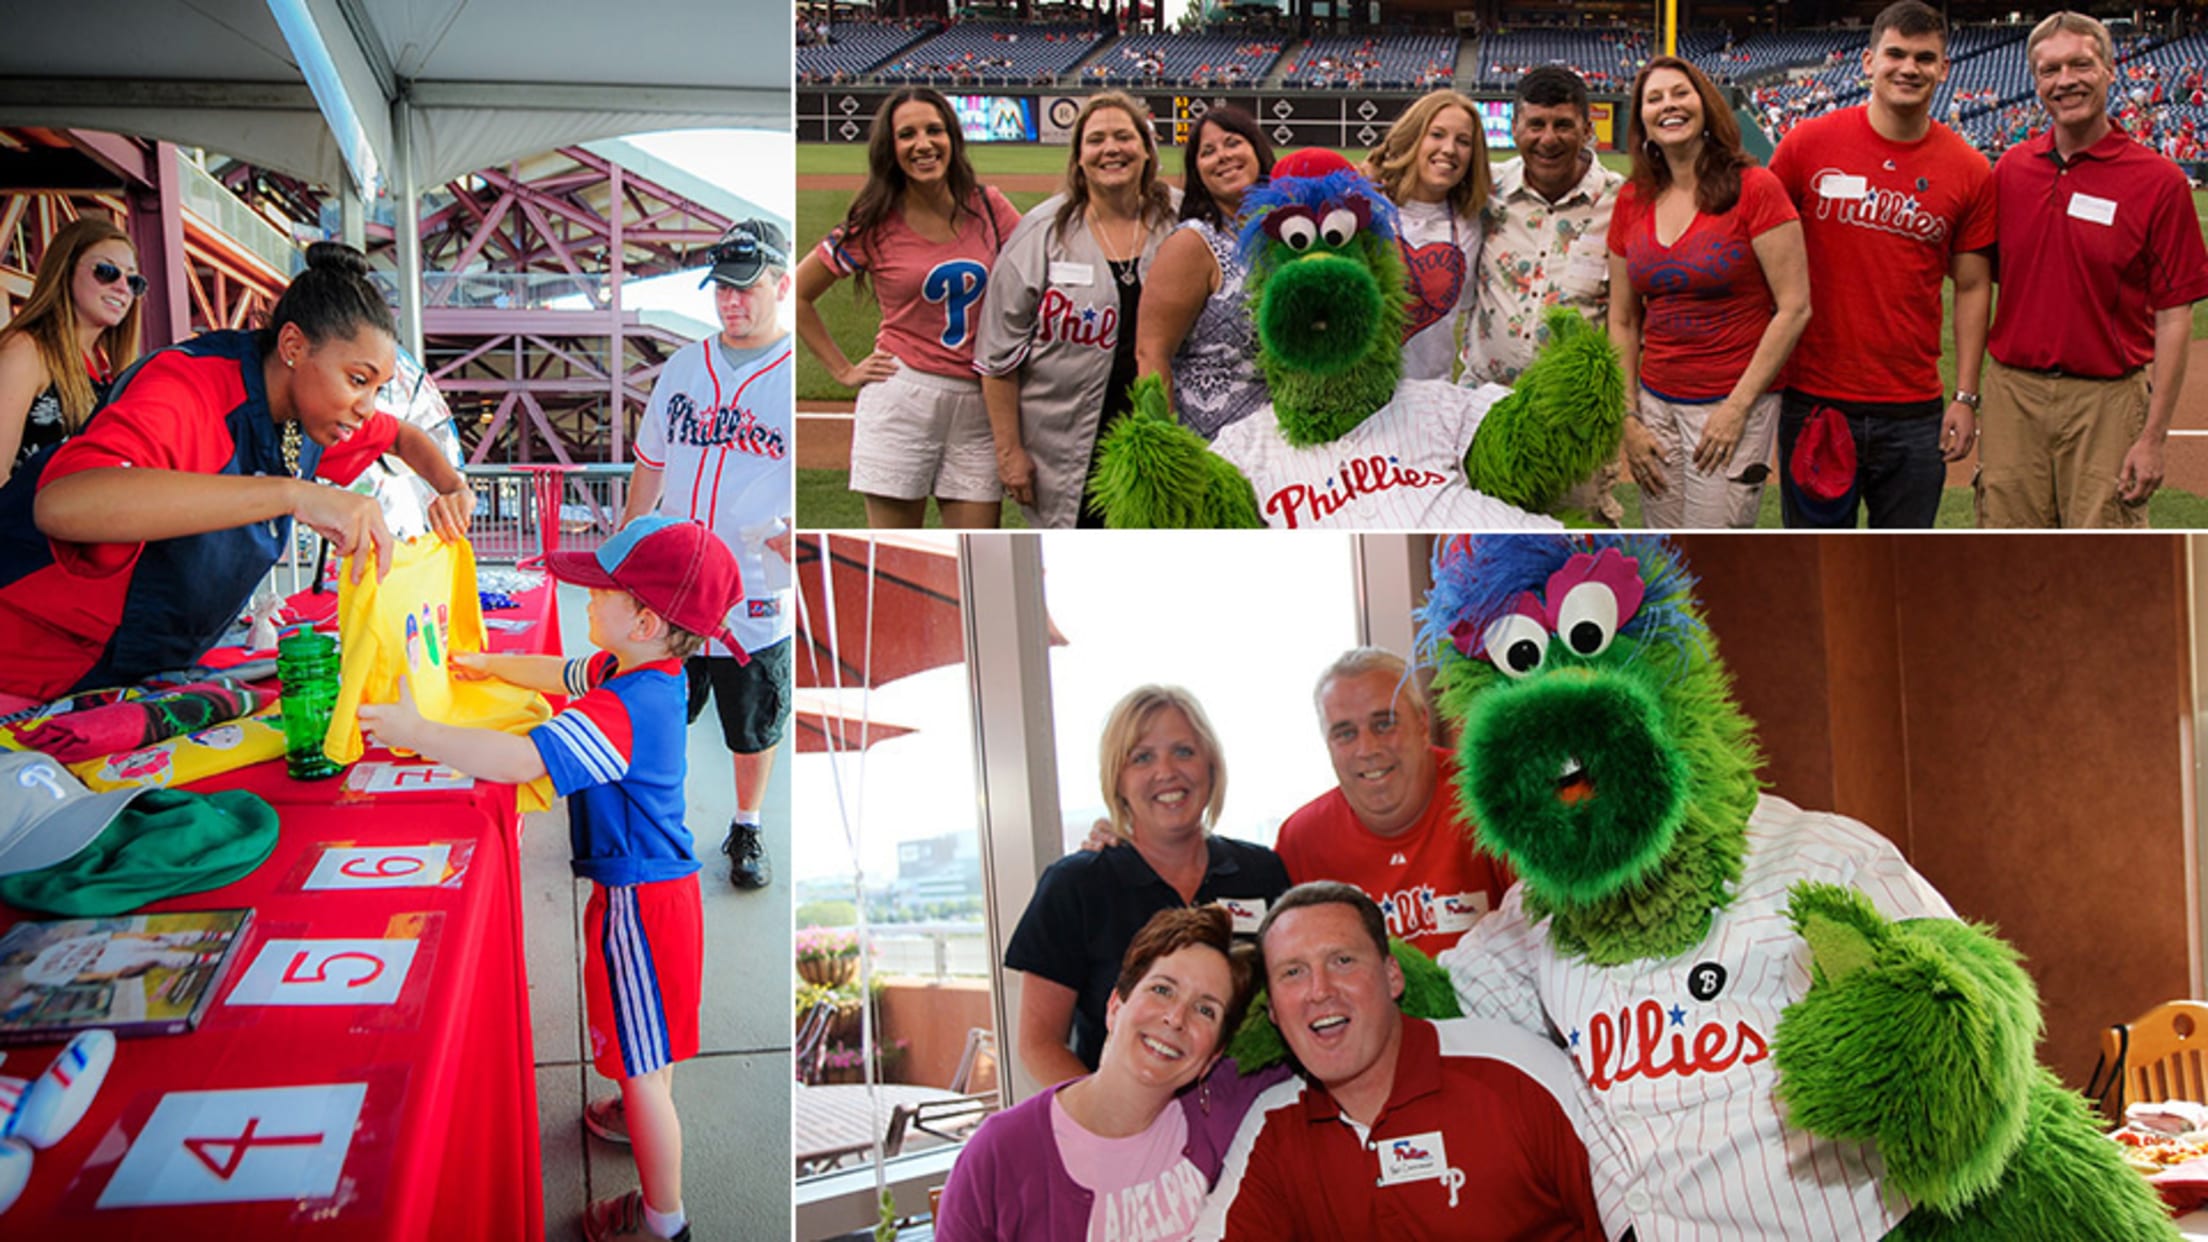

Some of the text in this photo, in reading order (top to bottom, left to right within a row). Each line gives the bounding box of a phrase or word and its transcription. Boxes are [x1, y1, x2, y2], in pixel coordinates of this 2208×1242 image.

[923, 259, 988, 348] P
[1037, 288, 1119, 350] Phil
[1266, 455, 1447, 528] Phillies
[340, 855, 425, 879] 6
[281, 950, 387, 989] 5
[182, 1117, 325, 1182] 4
[1440, 1166, 1466, 1208] P
